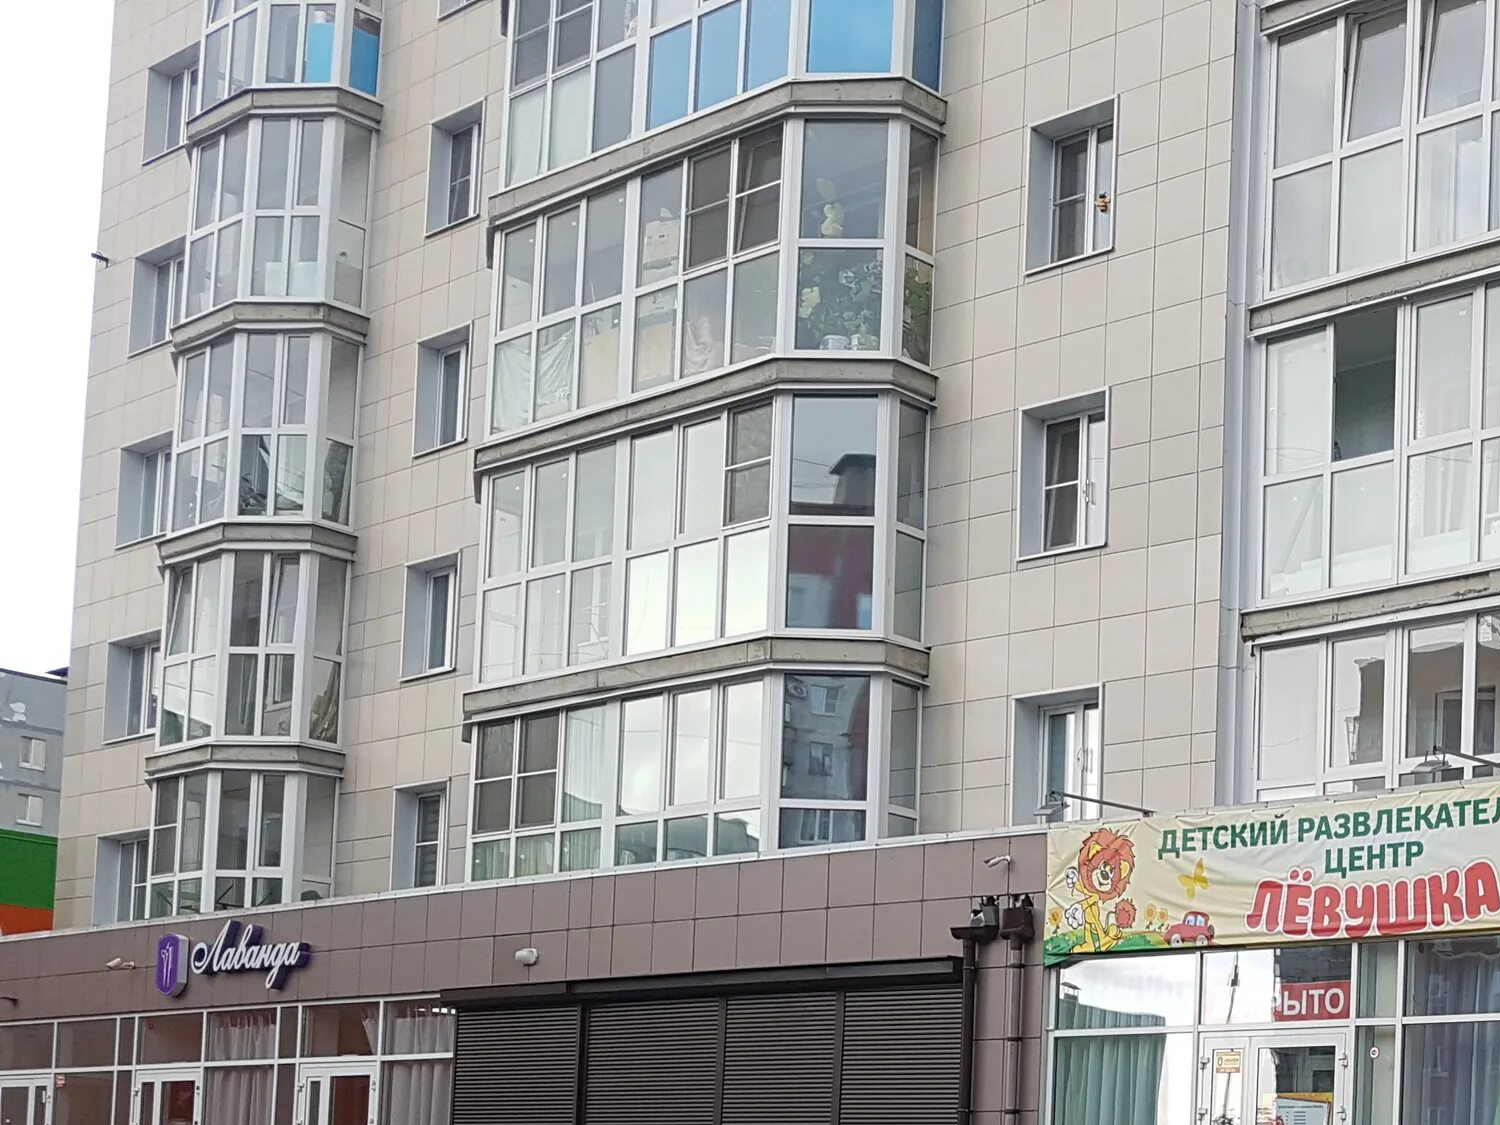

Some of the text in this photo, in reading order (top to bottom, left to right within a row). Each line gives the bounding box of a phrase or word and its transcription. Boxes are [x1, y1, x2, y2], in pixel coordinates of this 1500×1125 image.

[1158, 814, 1288, 860] ДЕТСКИЙ
[1324, 840, 1424, 878] ЦЕНТР
[190, 919, 303, 989] Лаванда
